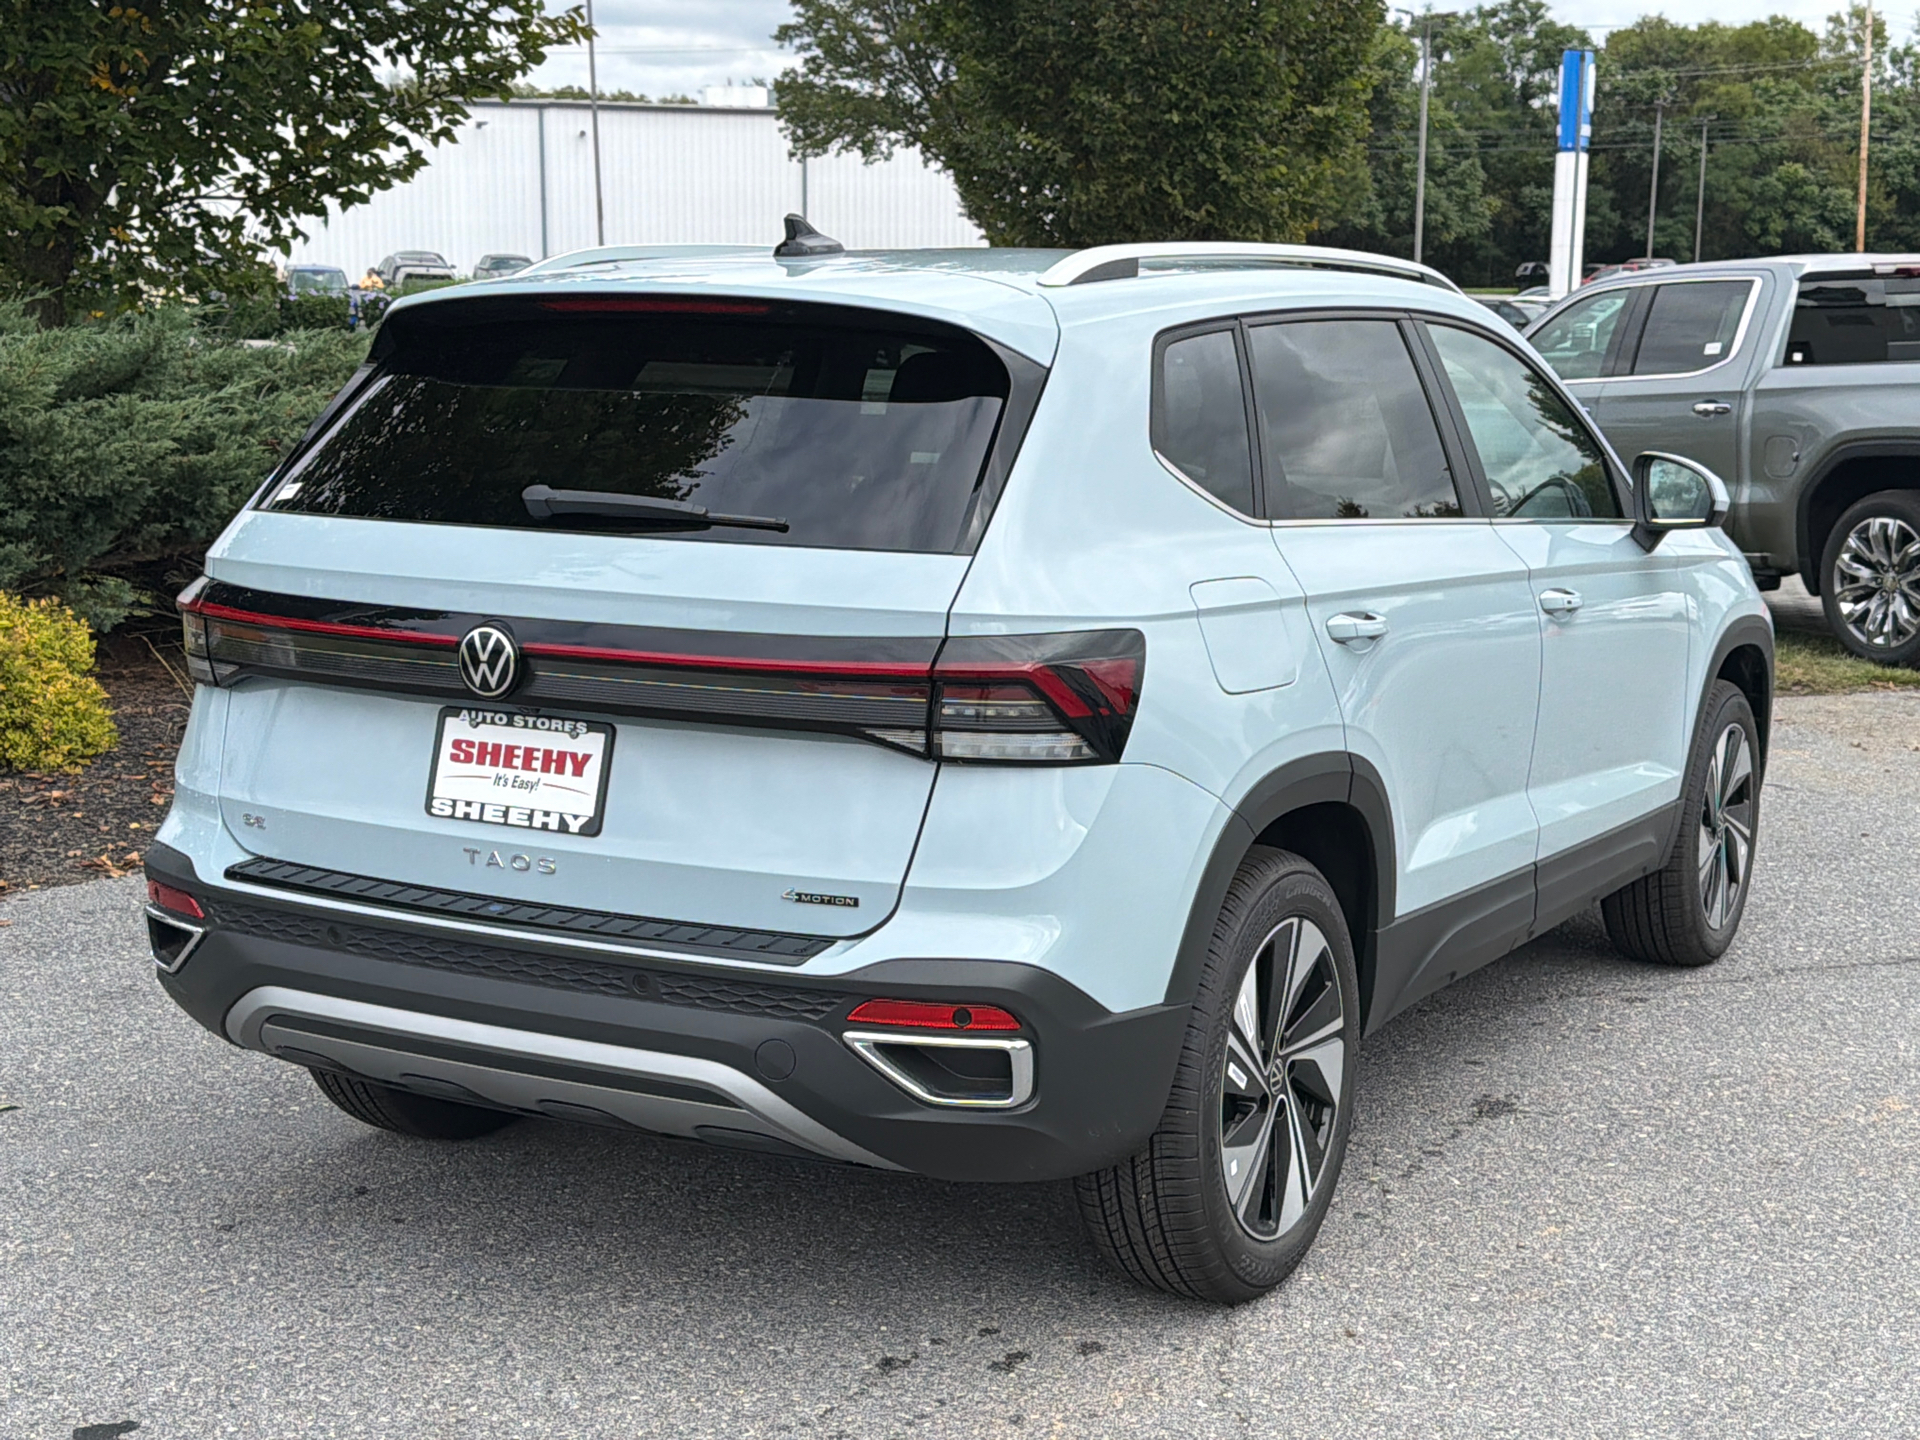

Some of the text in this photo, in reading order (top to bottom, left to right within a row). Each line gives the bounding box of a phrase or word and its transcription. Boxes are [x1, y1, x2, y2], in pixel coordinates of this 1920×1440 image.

[458, 709, 588, 735] AUTO STORES
[449, 738, 594, 778] SHEEHY
[493, 772, 541, 794] It's Easy!
[430, 797, 590, 833] SHEEHY
[462, 847, 557, 875] TAOS
